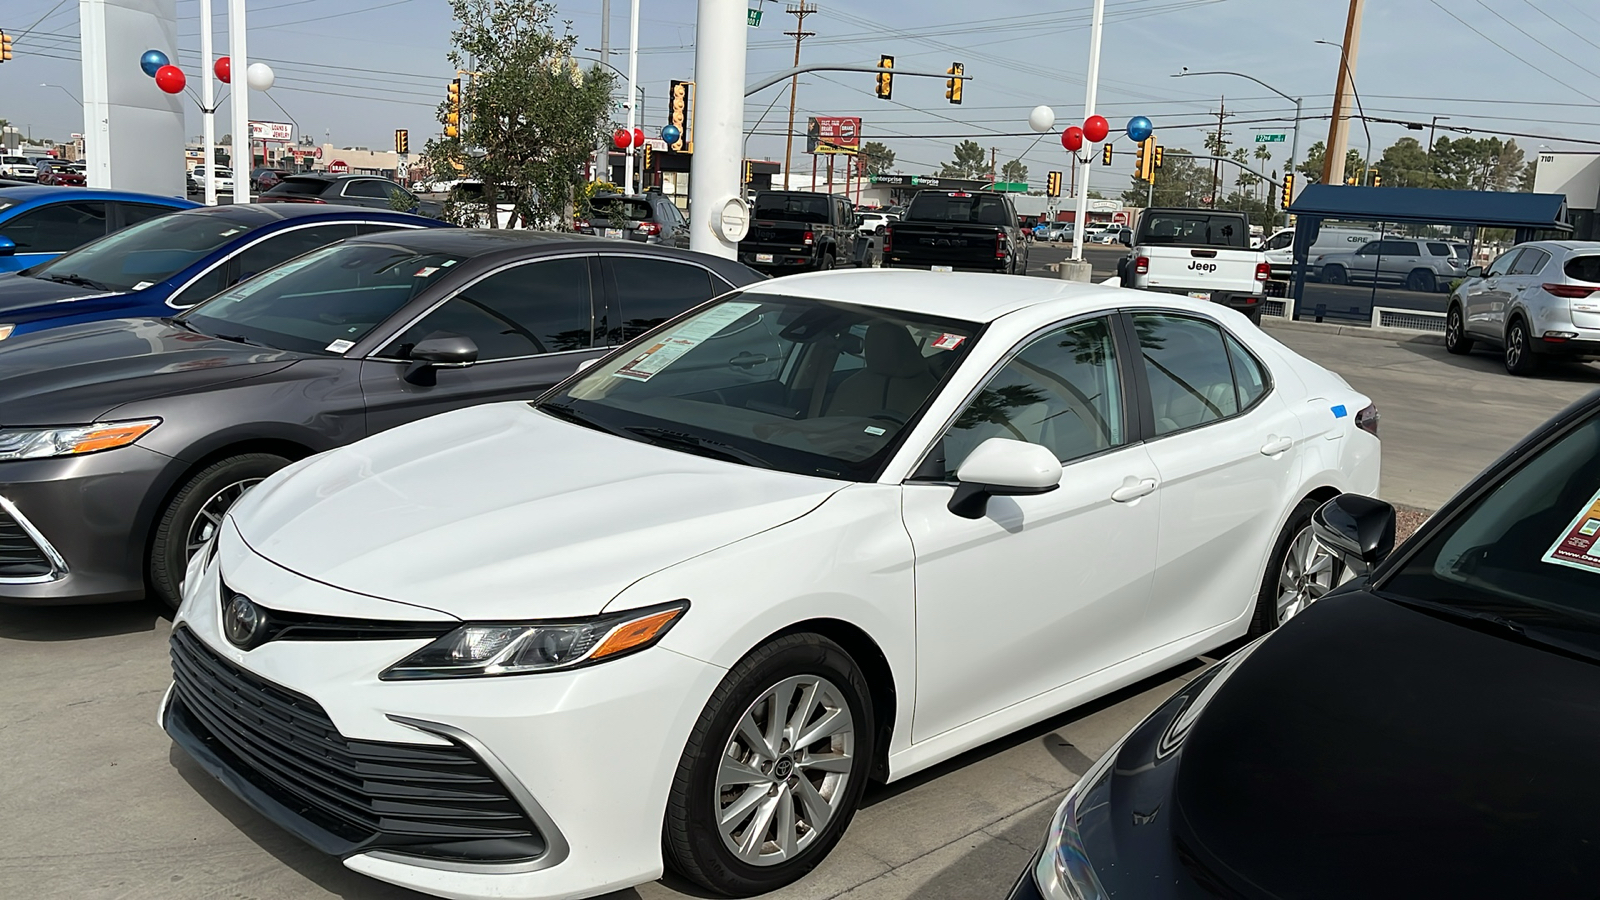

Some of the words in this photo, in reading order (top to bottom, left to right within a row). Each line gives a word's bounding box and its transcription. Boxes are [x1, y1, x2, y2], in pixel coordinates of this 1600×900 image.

[1540, 155, 1554, 163] 7101
[912, 177, 940, 185] enterprise
[919, 238, 968, 246] RAM
[1187, 260, 1217, 273] Jeep
